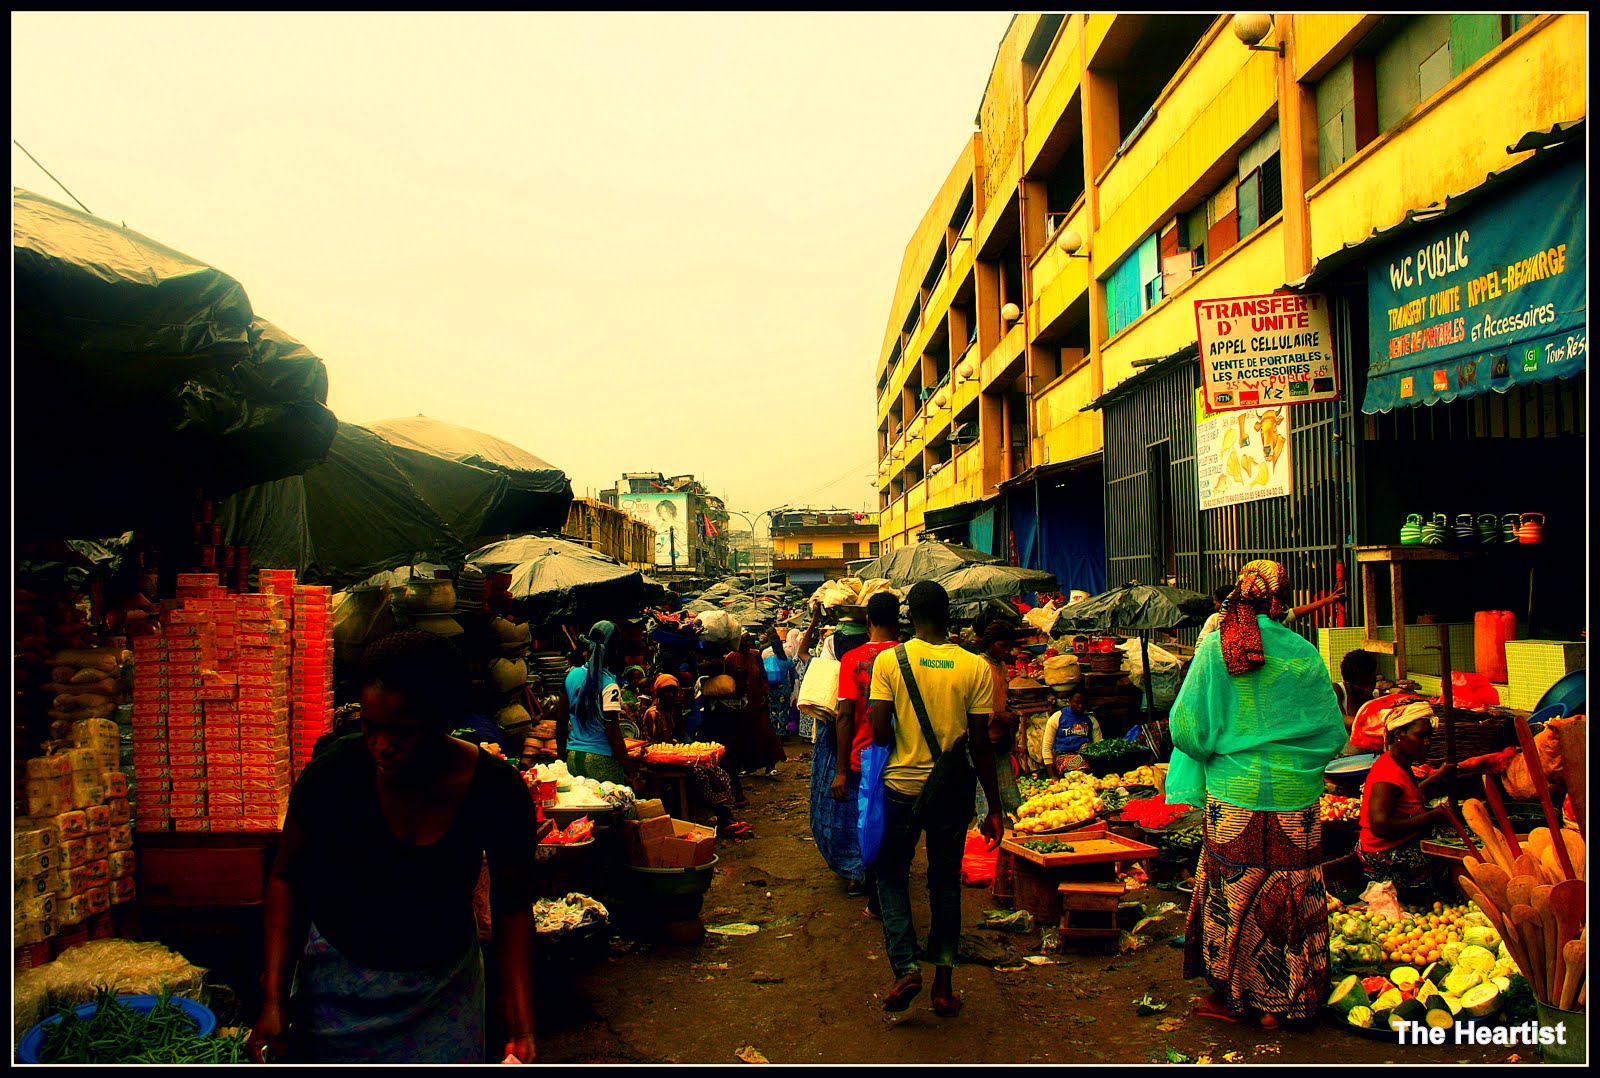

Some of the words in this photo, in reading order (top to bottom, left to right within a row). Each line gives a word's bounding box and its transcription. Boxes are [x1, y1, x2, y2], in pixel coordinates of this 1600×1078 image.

[1389, 256, 1414, 291] WC
[1417, 229, 1470, 286] PUBLIC
[1387, 297, 1428, 331] TRANSFERT
[1467, 243, 1567, 308] APPEL-RECHARGE
[1202, 294, 1322, 320] TRANSFERT
[1251, 312, 1309, 332] UNITE
[1483, 303, 1556, 339] Accessoires
[1210, 338, 1247, 356] APPEL
[1250, 331, 1319, 351] CELLULAIRE
[1545, 342, 1566, 364] Tous
[1212, 360, 1244, 371] VENTE
[1247, 358, 1257, 367] DE
[1259, 351, 1322, 367] PORTABLES
[1212, 371, 1233, 382] LES
[1237, 363, 1311, 379] ACCESSOIRES
[610, 689, 620, 702] 2
